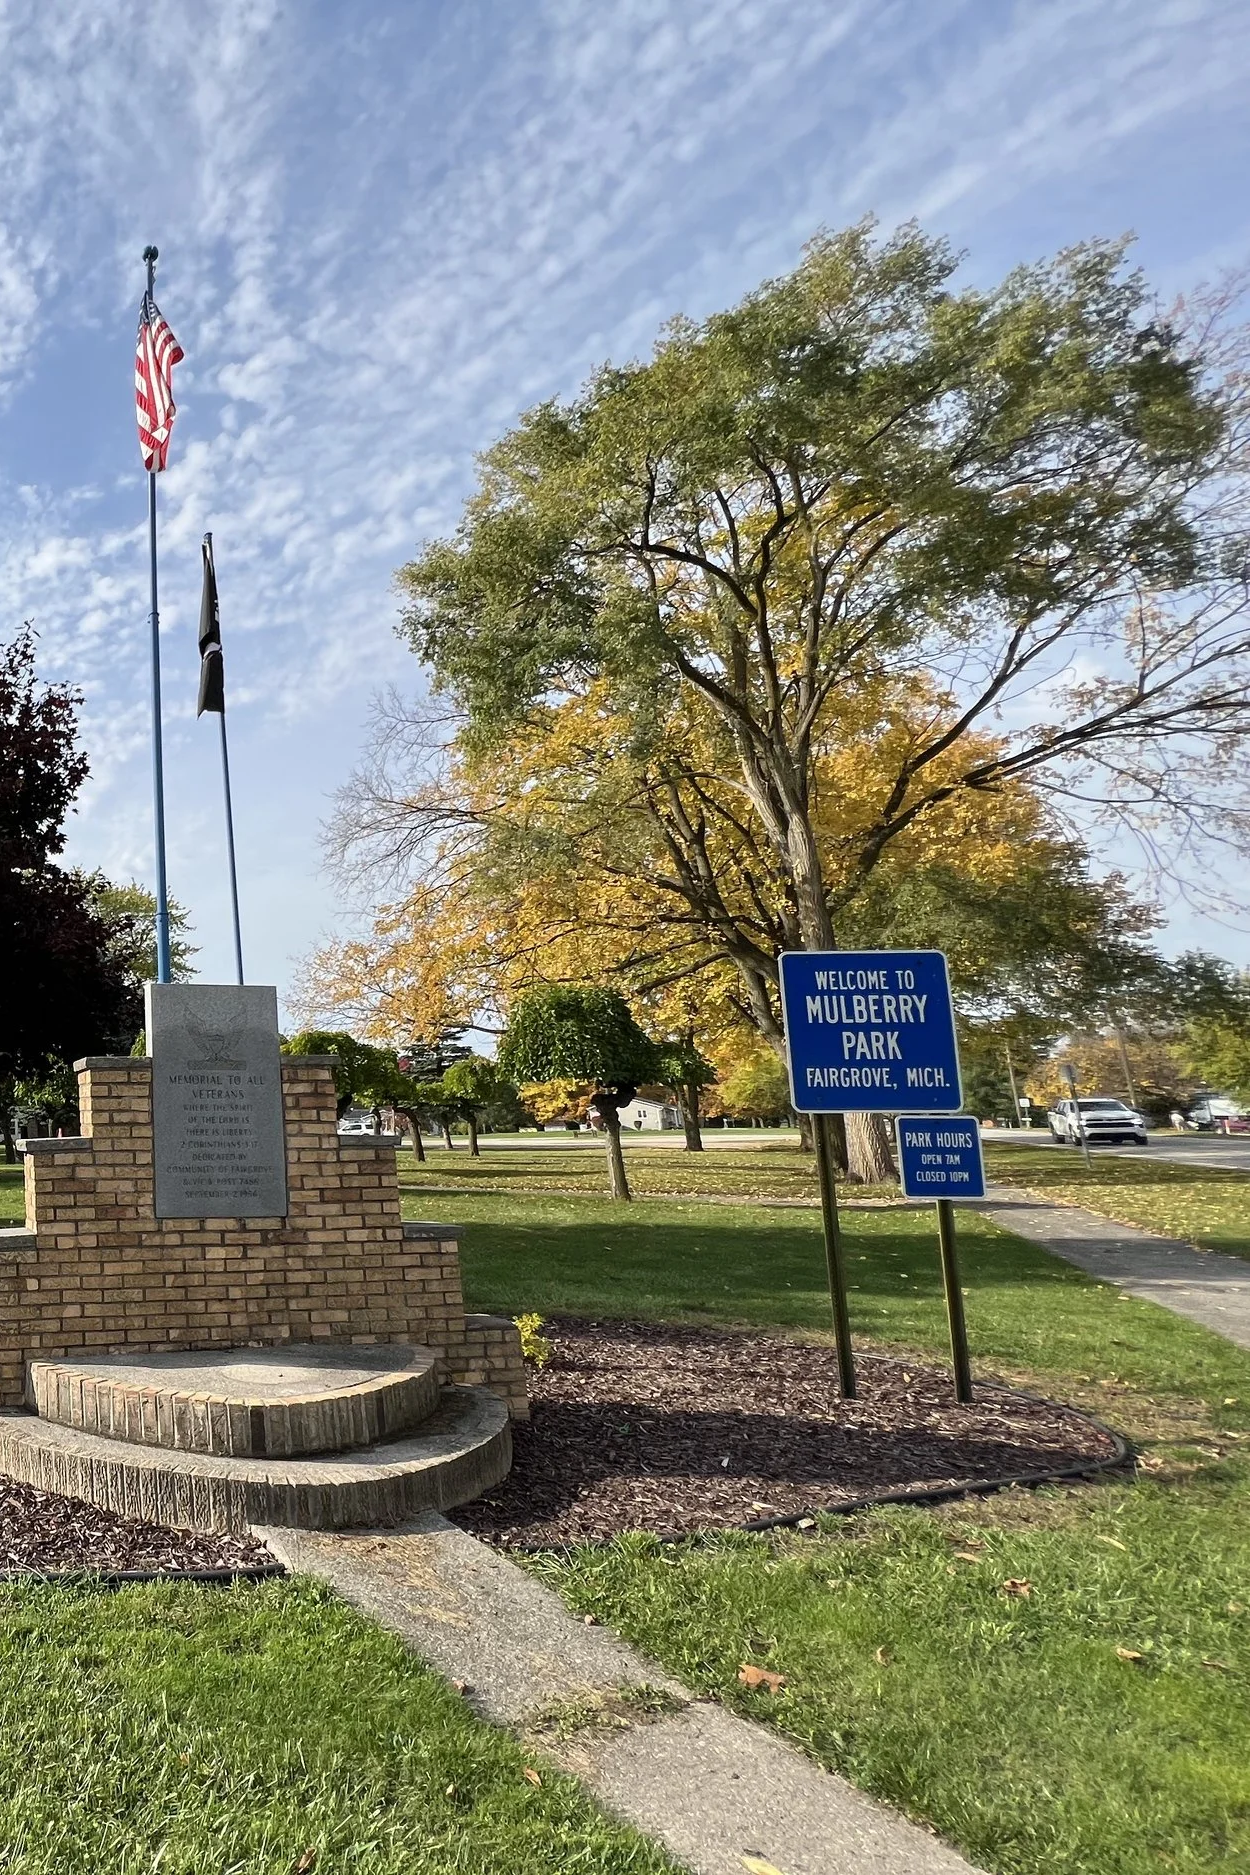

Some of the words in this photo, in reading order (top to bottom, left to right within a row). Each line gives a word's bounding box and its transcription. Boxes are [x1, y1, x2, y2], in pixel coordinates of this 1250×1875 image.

[815, 970, 889, 990] WELCOME
[895, 970, 915, 990] TO
[805, 994, 928, 1024] MULBERRY
[842, 1031, 903, 1060] PARK
[169, 1075, 222, 1085] MEMORIAL
[228, 1075, 241, 1085] TO
[247, 1075, 265, 1085] ALL
[806, 1067, 898, 1090] FAIRGROVE,
[906, 1067, 950, 1088] MICH.
[192, 1089, 245, 1099] VETERANS
[183, 1103, 209, 1111] WHERE
[213, 1103, 227, 1111] THE
[230, 1103, 253, 1111] SPIRIT
[188, 1116, 197, 1124] OF
[202, 1116, 216, 1124] THE
[218, 1116, 239, 1124] LORD
[241, 1116, 250, 1124] IS
[186, 1128, 209, 1136] THERE
[212, 1128, 220, 1136] IS
[222, 1128, 253, 1136] LIBERTY
[905, 1132, 933, 1148] PARK
[936, 1132, 973, 1148] HOURS
[192, 1153, 236, 1161] DEDICATED
[238, 1153, 247, 1161] BY
[921, 1154, 943, 1165] OPEN
[944, 1154, 961, 1165] 7AM
[166, 1165, 215, 1174] COMMUNITY
[218, 1165, 228, 1174] OF
[231, 1165, 275, 1174] FAIRGROVE
[916, 1171, 946, 1182] CLOSED
[949, 1171, 970, 1182] 10PM
